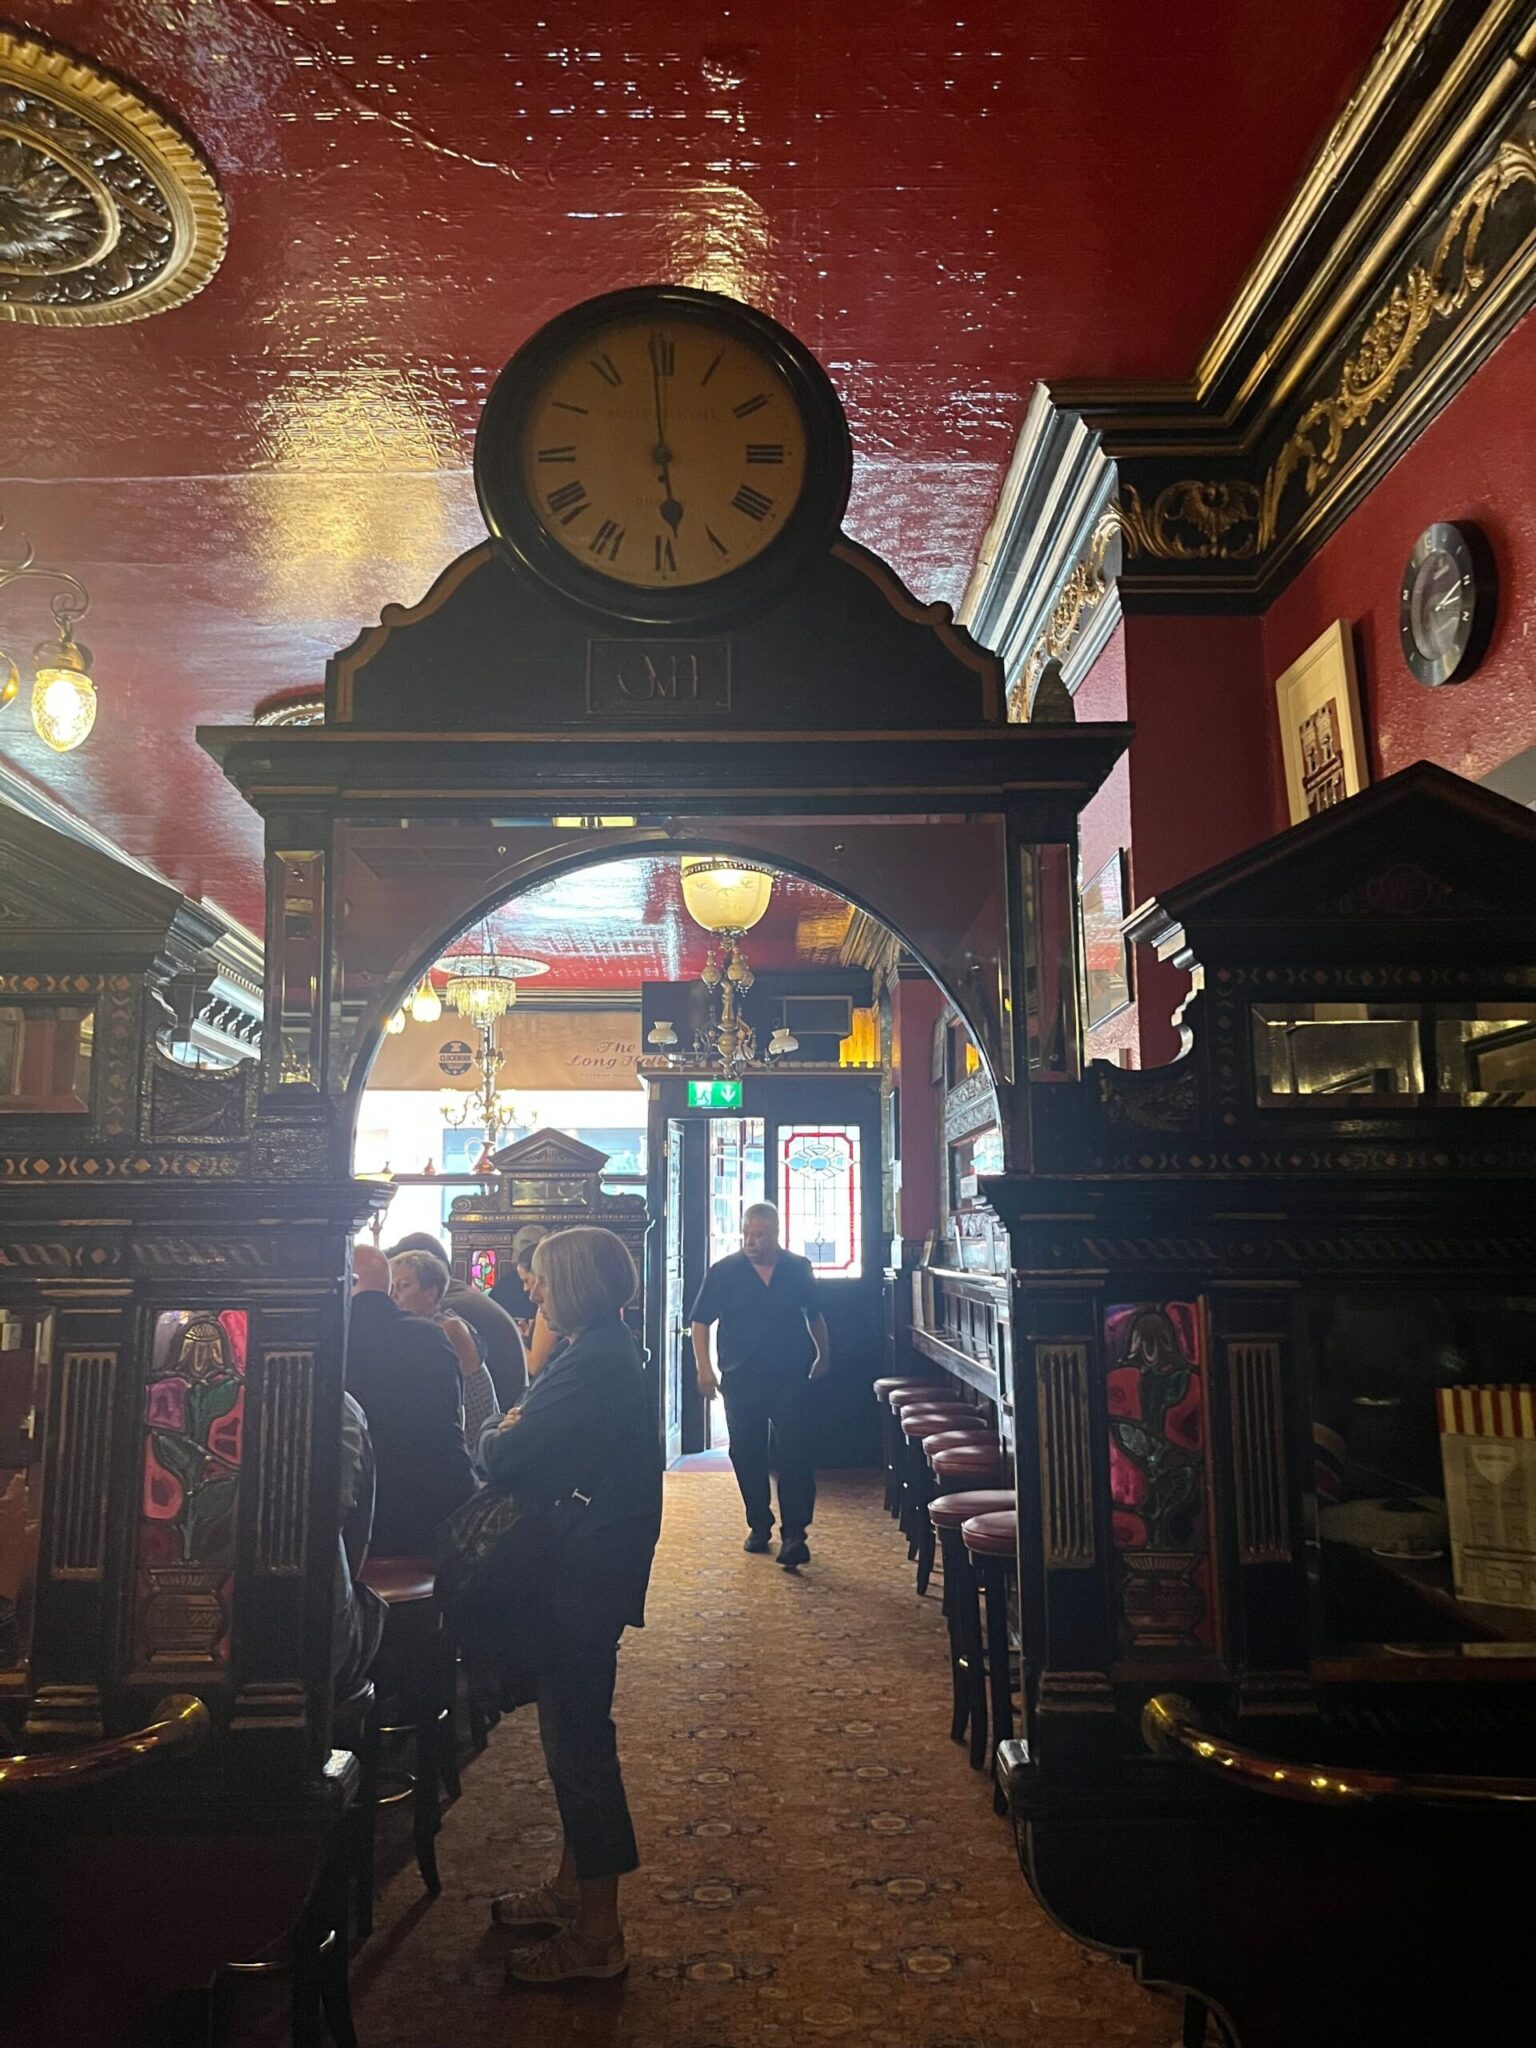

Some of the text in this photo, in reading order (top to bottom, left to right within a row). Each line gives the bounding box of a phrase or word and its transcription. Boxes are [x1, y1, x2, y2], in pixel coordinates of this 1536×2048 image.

[745, 443, 785, 465] III
[597, 1041, 636, 1053] The
[565, 1054, 617, 1069] Long
